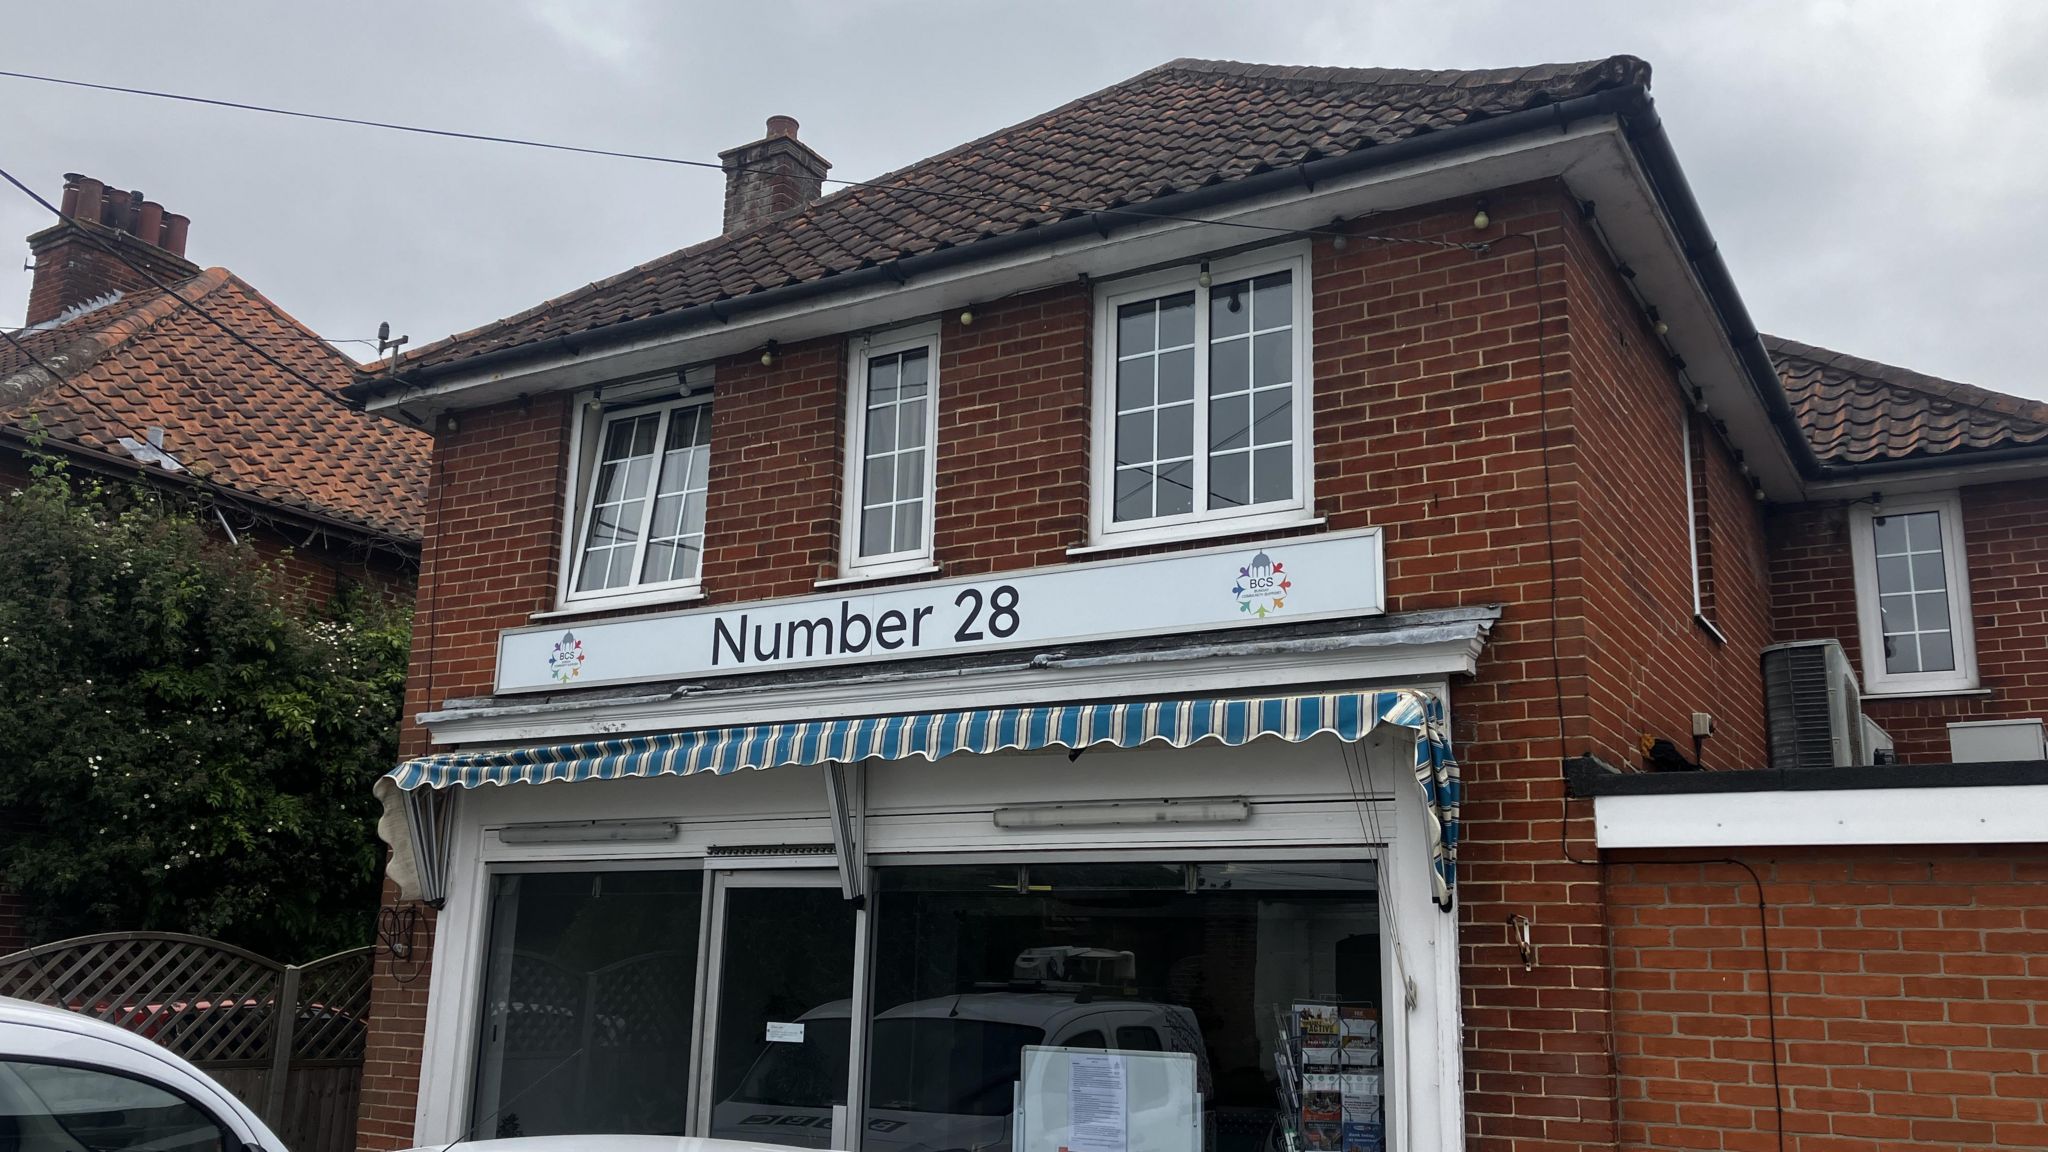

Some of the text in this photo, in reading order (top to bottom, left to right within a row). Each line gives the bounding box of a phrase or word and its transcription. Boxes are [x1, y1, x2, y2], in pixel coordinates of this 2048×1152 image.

[1250, 577, 1273, 589] BCS
[711, 585, 1020, 666] Number 28
[560, 651, 575, 660] BCS
